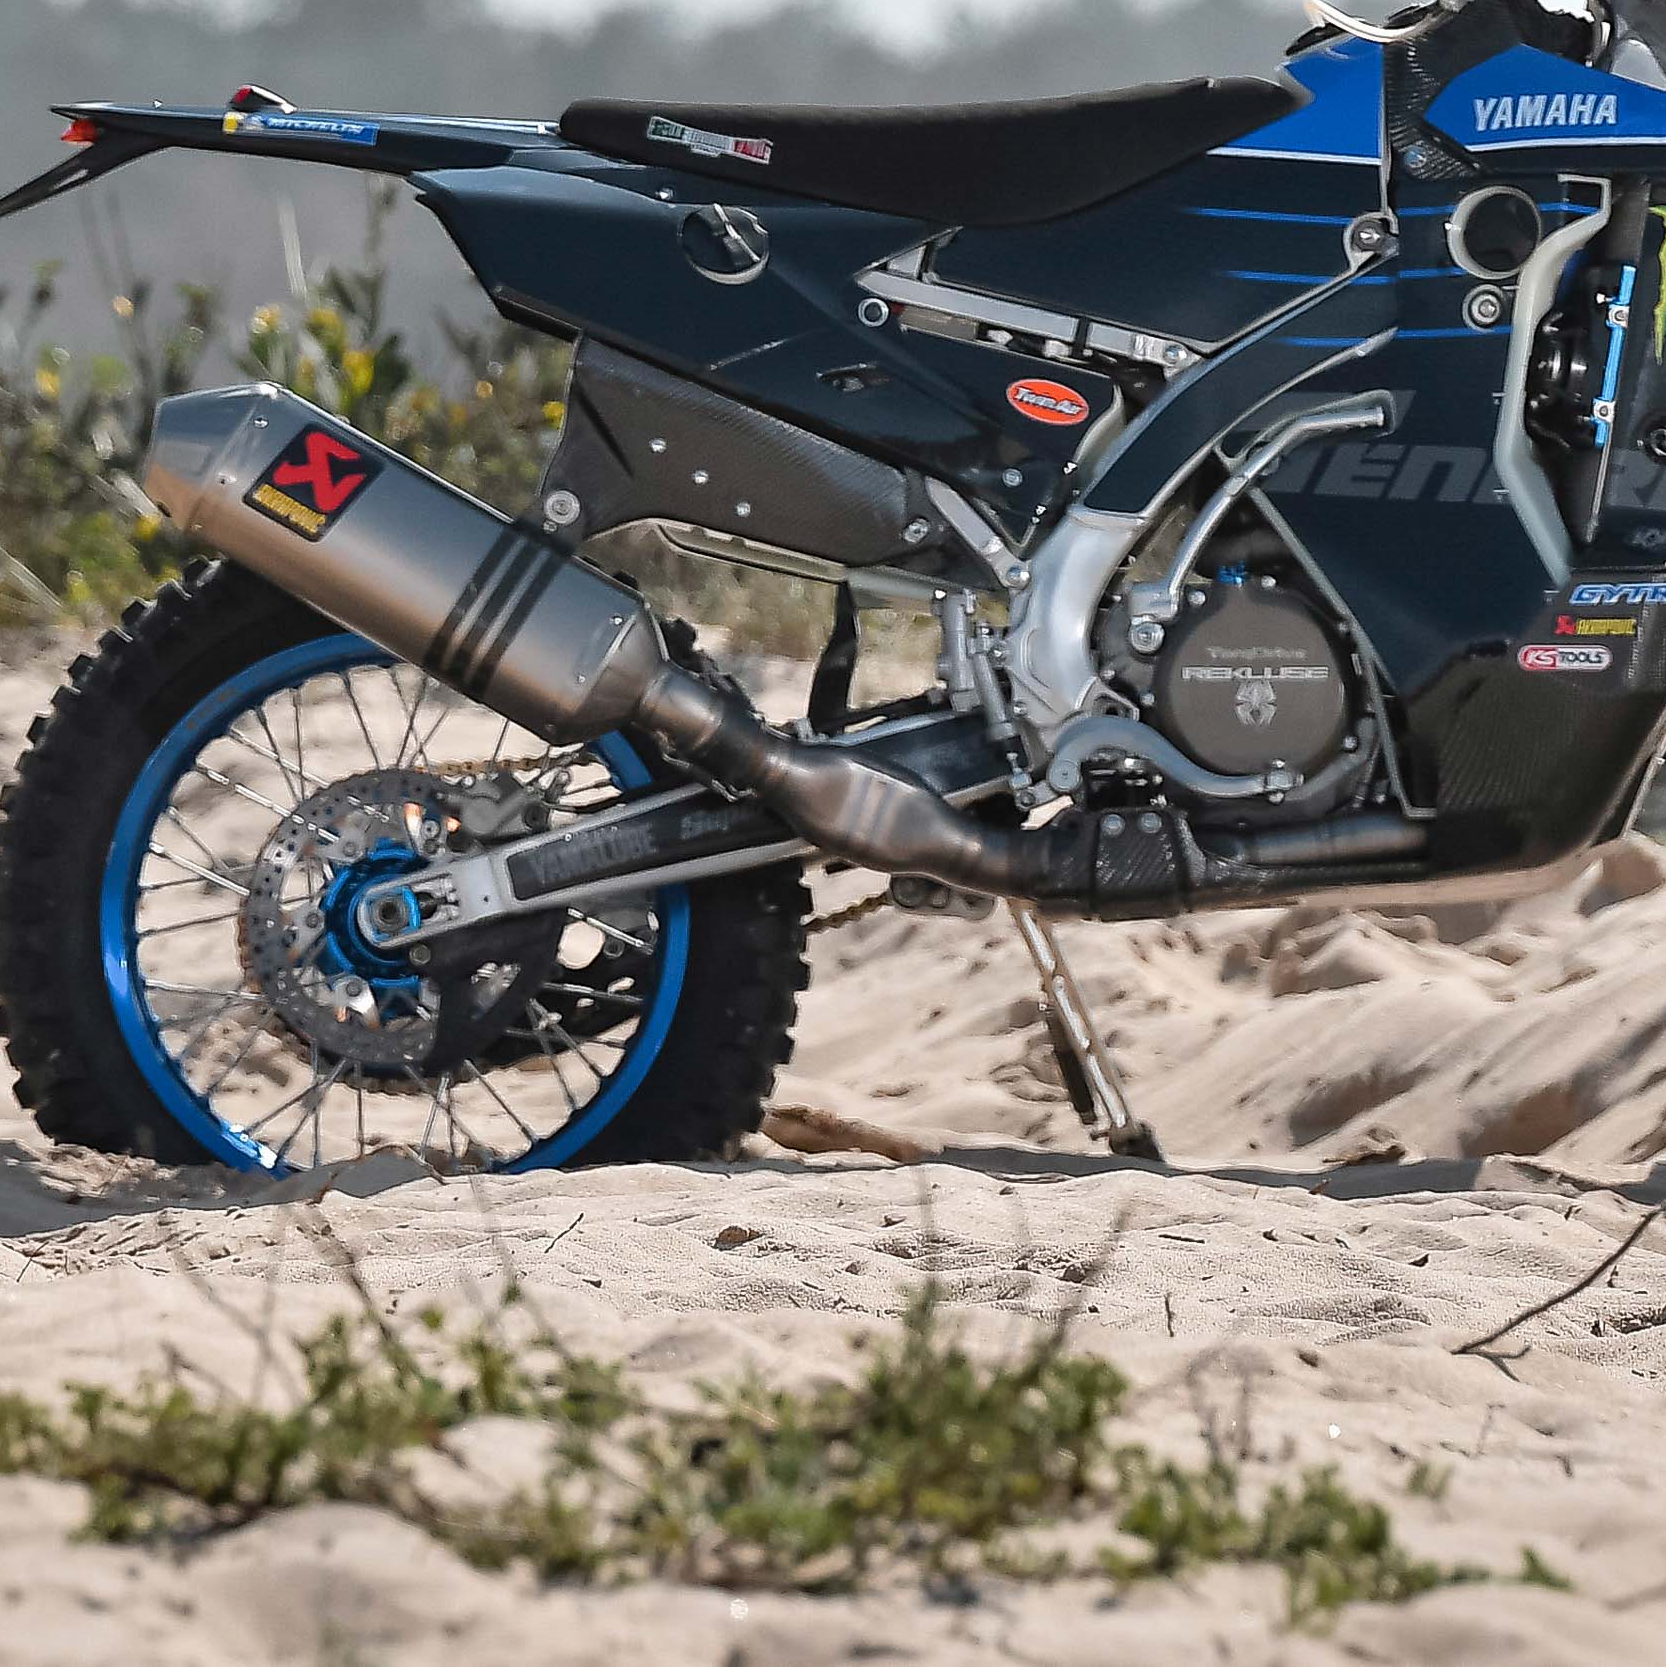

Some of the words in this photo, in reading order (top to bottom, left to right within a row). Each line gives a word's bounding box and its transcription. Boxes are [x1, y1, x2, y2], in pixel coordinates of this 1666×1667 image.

[1472, 93, 1620, 132] YAMAHA
[1524, 646, 1558, 668] KS
[1559, 651, 1603, 664] TOOLS
[1182, 666, 1329, 679] REKLUSE
